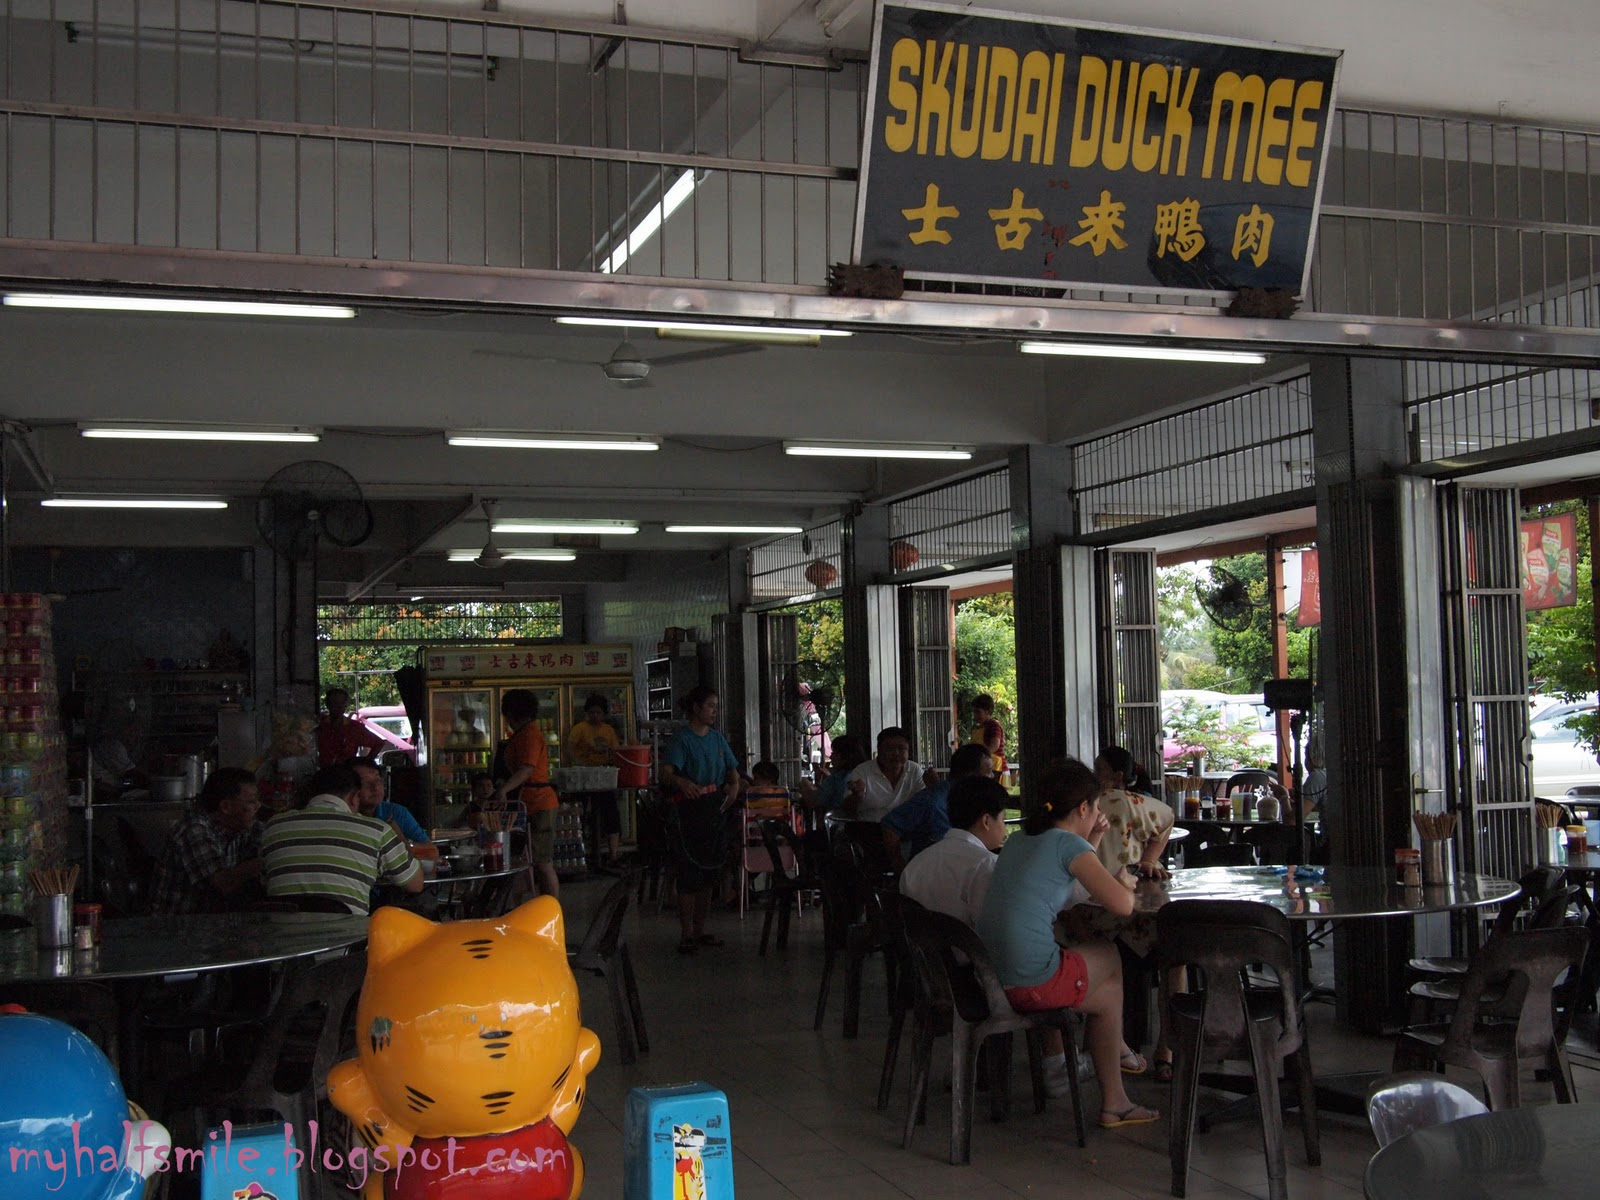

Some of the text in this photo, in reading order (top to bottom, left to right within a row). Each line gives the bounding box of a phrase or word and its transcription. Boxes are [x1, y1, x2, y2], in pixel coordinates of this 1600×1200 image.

[884, 37, 1323, 188] SKUDAI DUCK MEE
